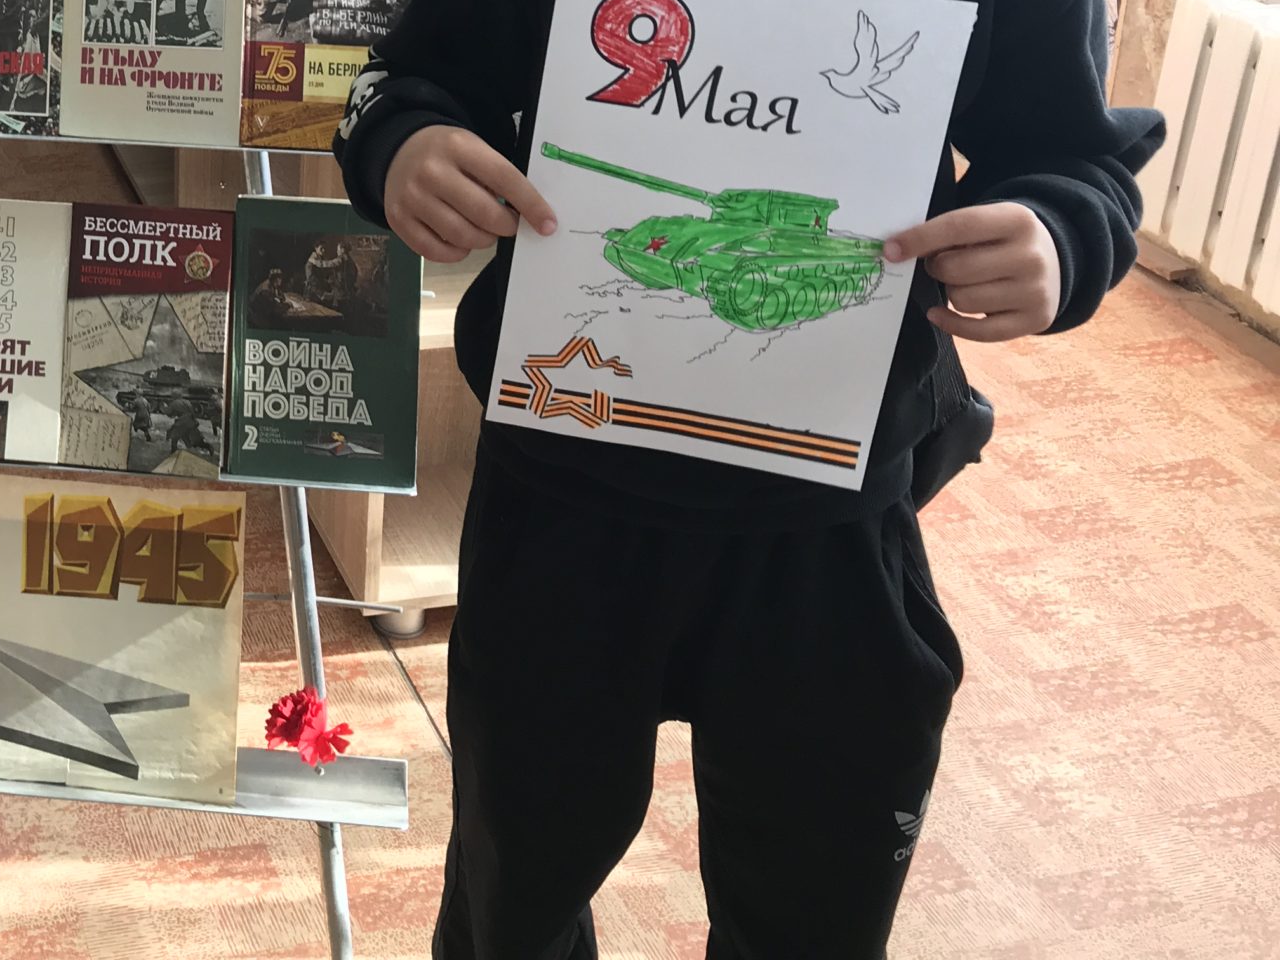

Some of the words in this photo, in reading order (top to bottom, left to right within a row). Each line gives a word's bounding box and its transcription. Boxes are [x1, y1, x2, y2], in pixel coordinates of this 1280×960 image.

[81, 47, 94, 65] В
[98, 47, 162, 68] ТЫЛУ
[255, 45, 297, 84] 75
[308, 61, 324, 76] НА
[80, 66, 94, 84] И
[99, 67, 127, 86] НА
[130, 69, 223, 92] ФРОНТЕ
[255, 83, 289, 92] ПОБЕДЫ
[652, 58, 801, 134] Мая
[83, 216, 222, 241] БЕССМЕРТНЫЙ
[82, 235, 178, 268] ПОЛК
[80, 275, 122, 286] ИСТОРИЯ
[81, 265, 162, 280] НЕПРИДУМАННАЯ
[245, 337, 354, 372] ВОЙНА
[244, 365, 353, 398] НАРОД
[243, 391, 372, 426] ПОБЕДА
[241, 424, 258, 450] 2
[20, 492, 242, 609] 1945
